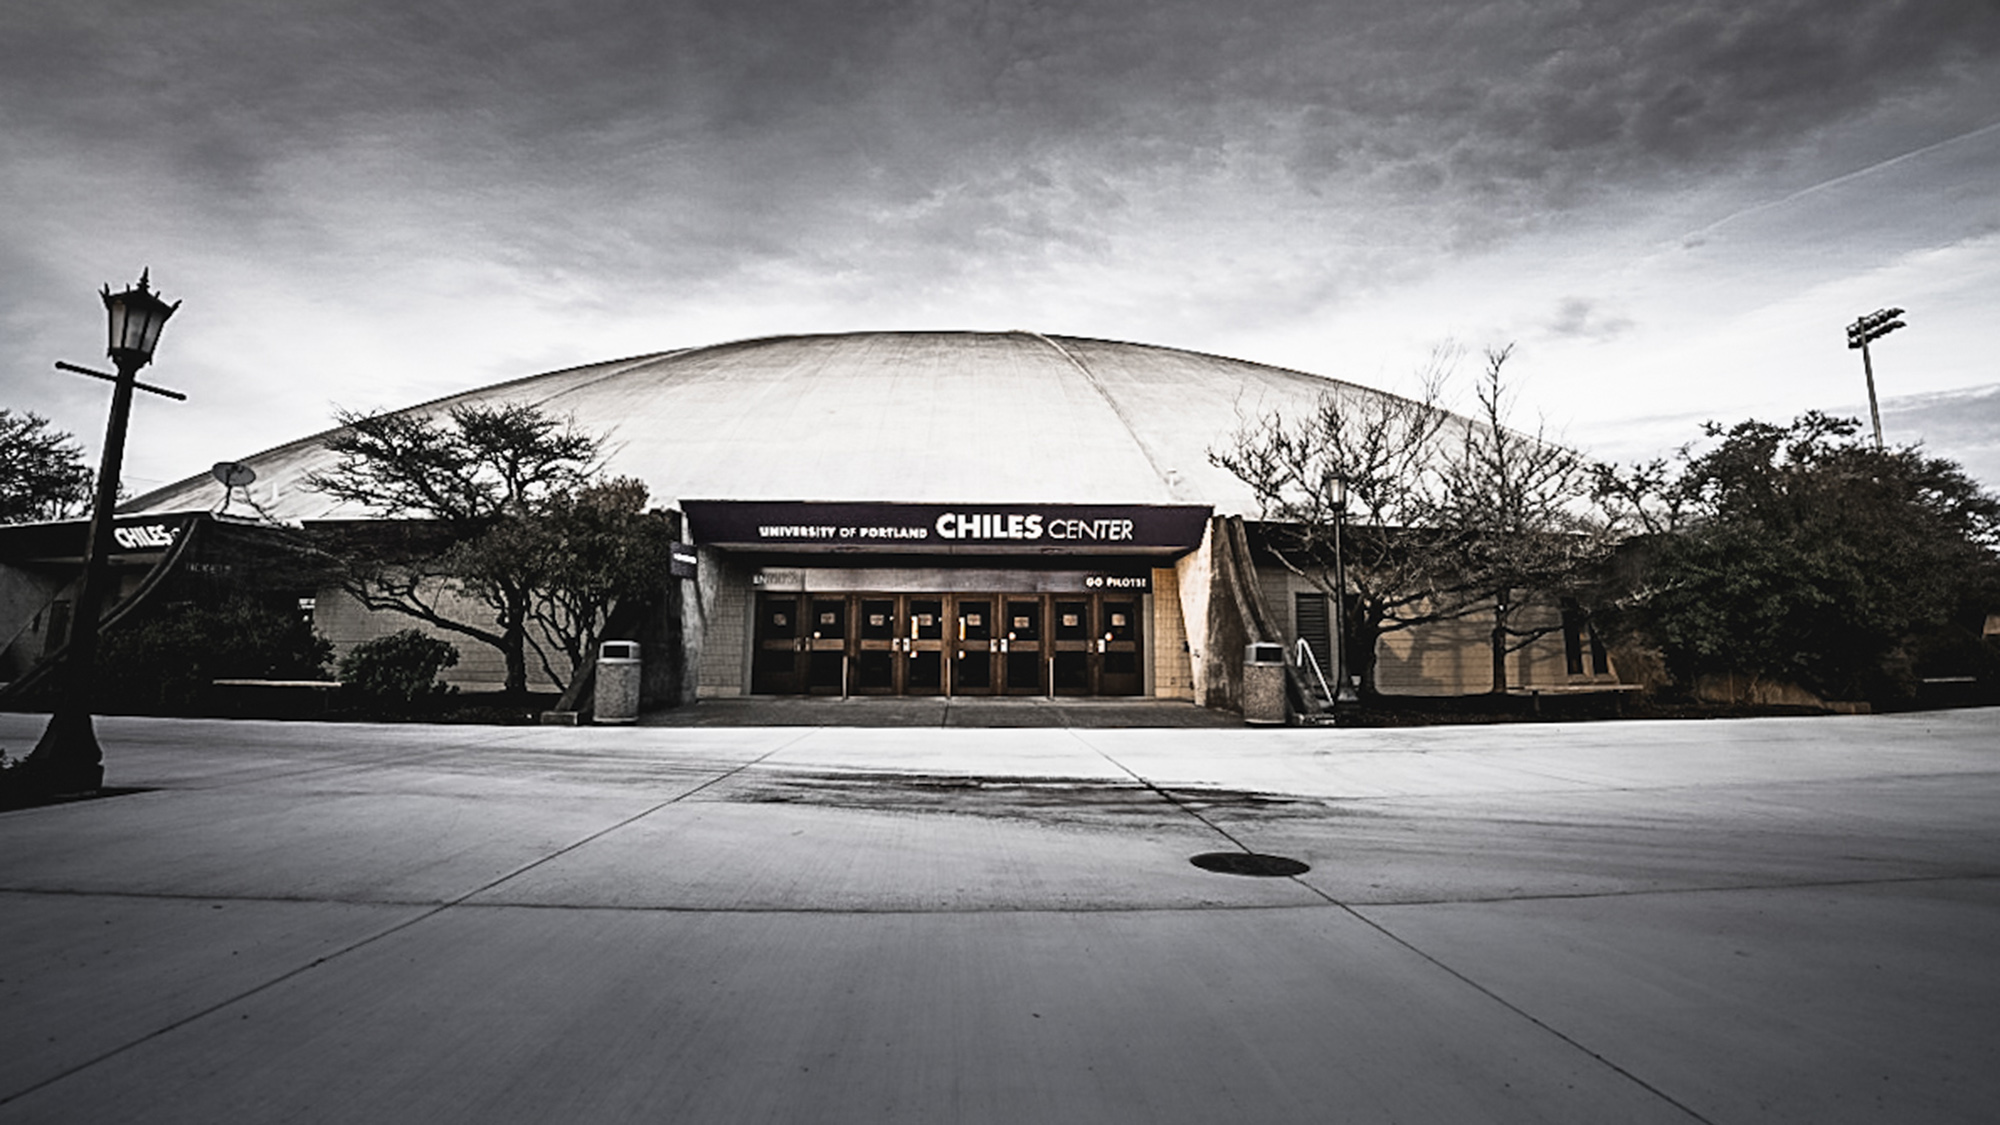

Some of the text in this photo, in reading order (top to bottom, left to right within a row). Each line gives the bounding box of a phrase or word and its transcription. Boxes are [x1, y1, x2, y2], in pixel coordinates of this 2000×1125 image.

[113, 524, 174, 549] CHILES
[759, 513, 1134, 540] UNIVERSITY OF PORTLAND CHILES CENTER
[1085, 576, 1103, 587] GO
